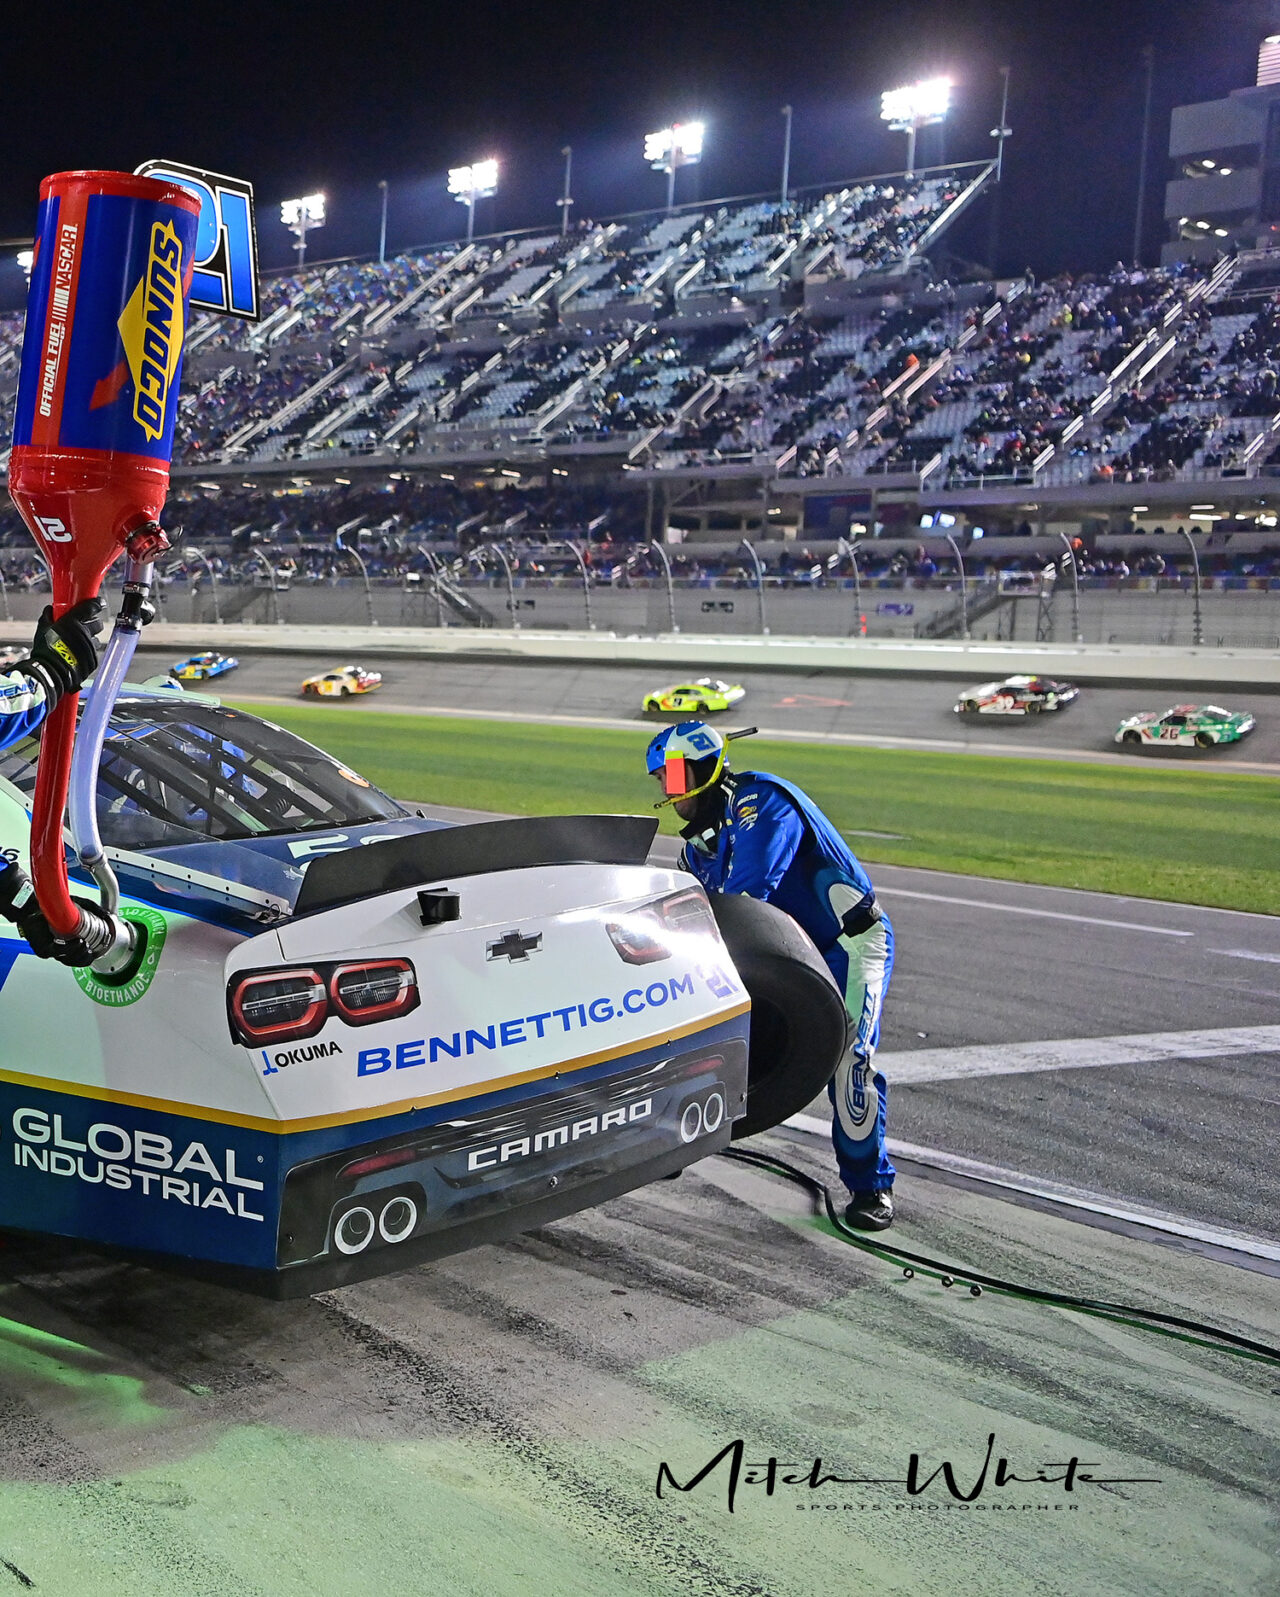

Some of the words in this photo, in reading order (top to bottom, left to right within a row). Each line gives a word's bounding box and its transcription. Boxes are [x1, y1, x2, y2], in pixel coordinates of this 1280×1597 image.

[54, 224, 79, 292] NASCAR
[47, 321, 62, 355] FUEL
[136, 231, 180, 432] SUNOCO
[39, 358, 57, 417] OFFICIAL
[687, 732, 717, 752] 21
[273, 1039, 343, 1069] OKUMA
[356, 972, 695, 1078] BENNETTIG.COM
[12, 1107, 264, 1191] GLOBAL
[467, 1098, 653, 1172] CAMARO
[14, 1143, 264, 1222] INDUSTRIAL
